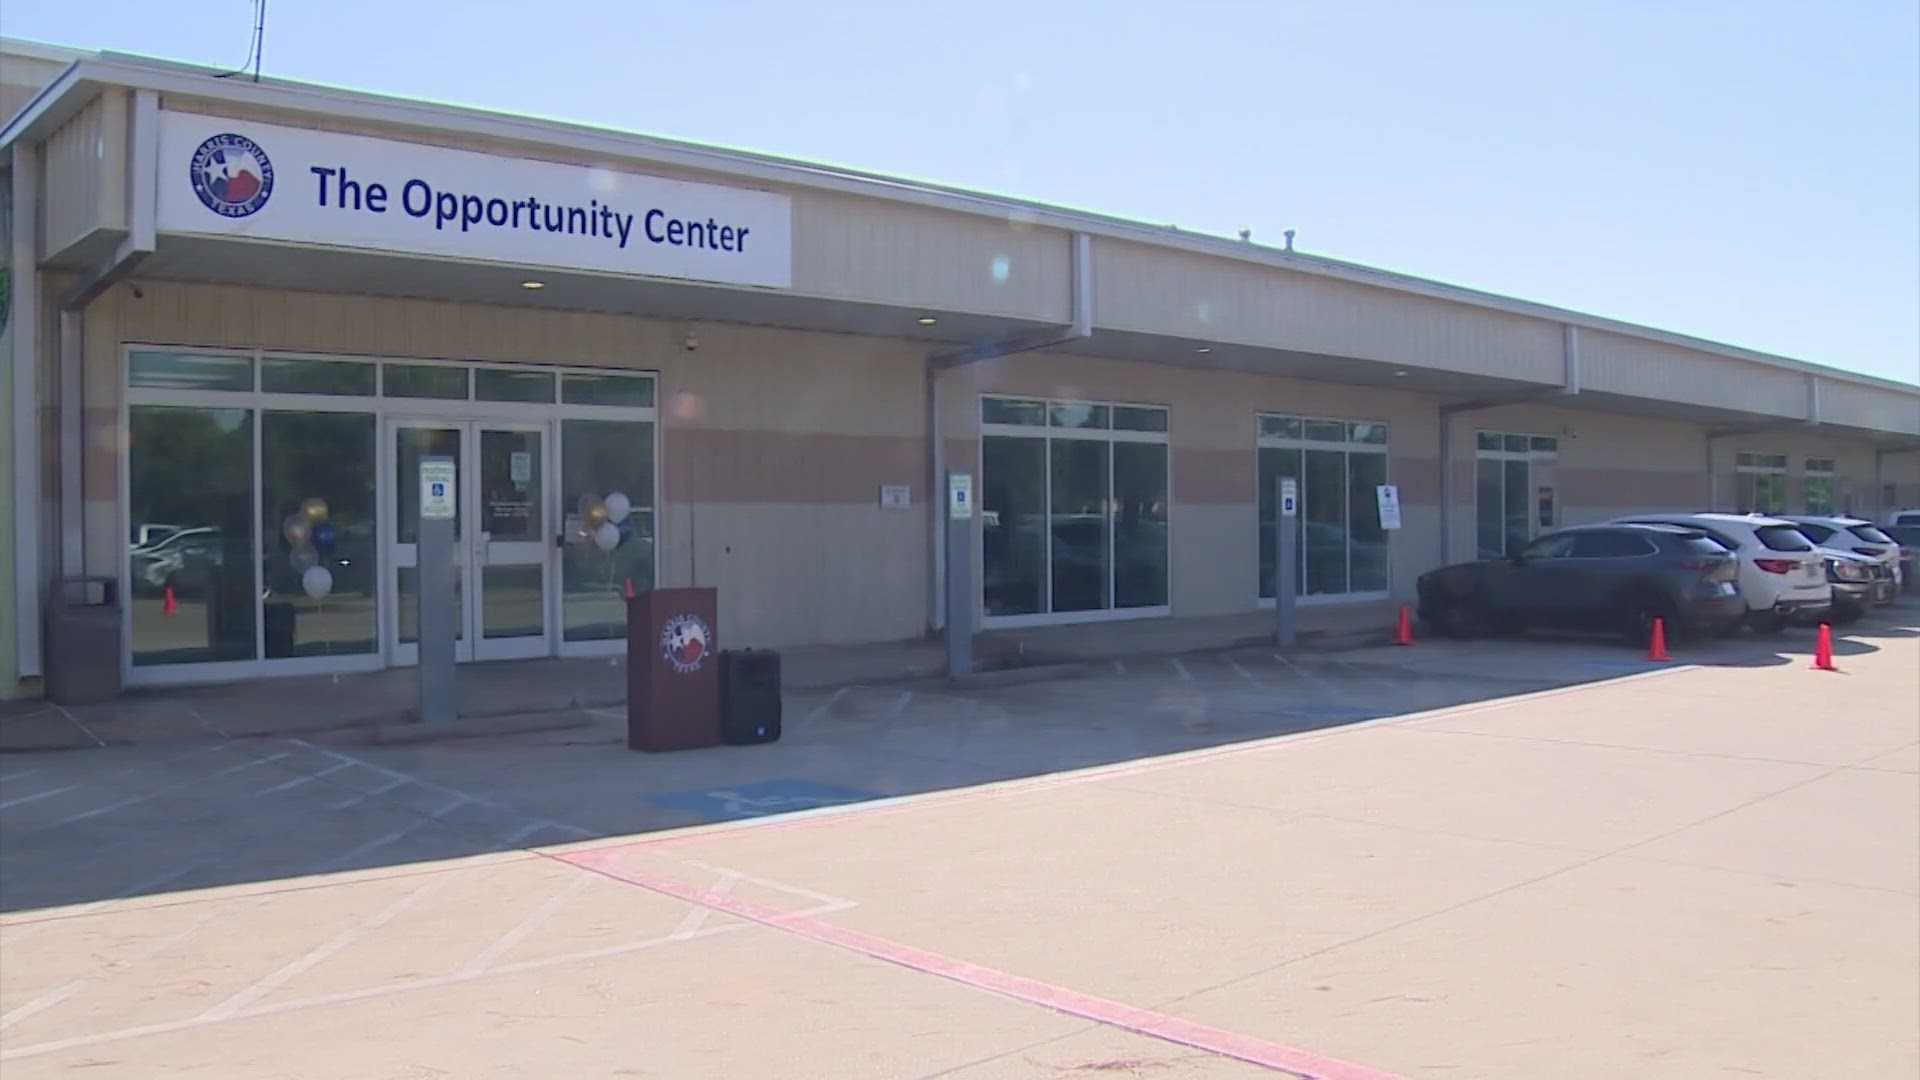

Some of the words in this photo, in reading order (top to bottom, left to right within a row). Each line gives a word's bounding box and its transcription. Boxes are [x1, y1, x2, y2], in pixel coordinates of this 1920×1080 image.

[191, 134, 230, 171] HARRIS
[233, 137, 272, 178] COUNTY
[210, 201, 256, 216] TEXAS
[309, 165, 389, 214] The
[401, 178, 635, 250] Opportunity
[644, 207, 751, 254] Center
